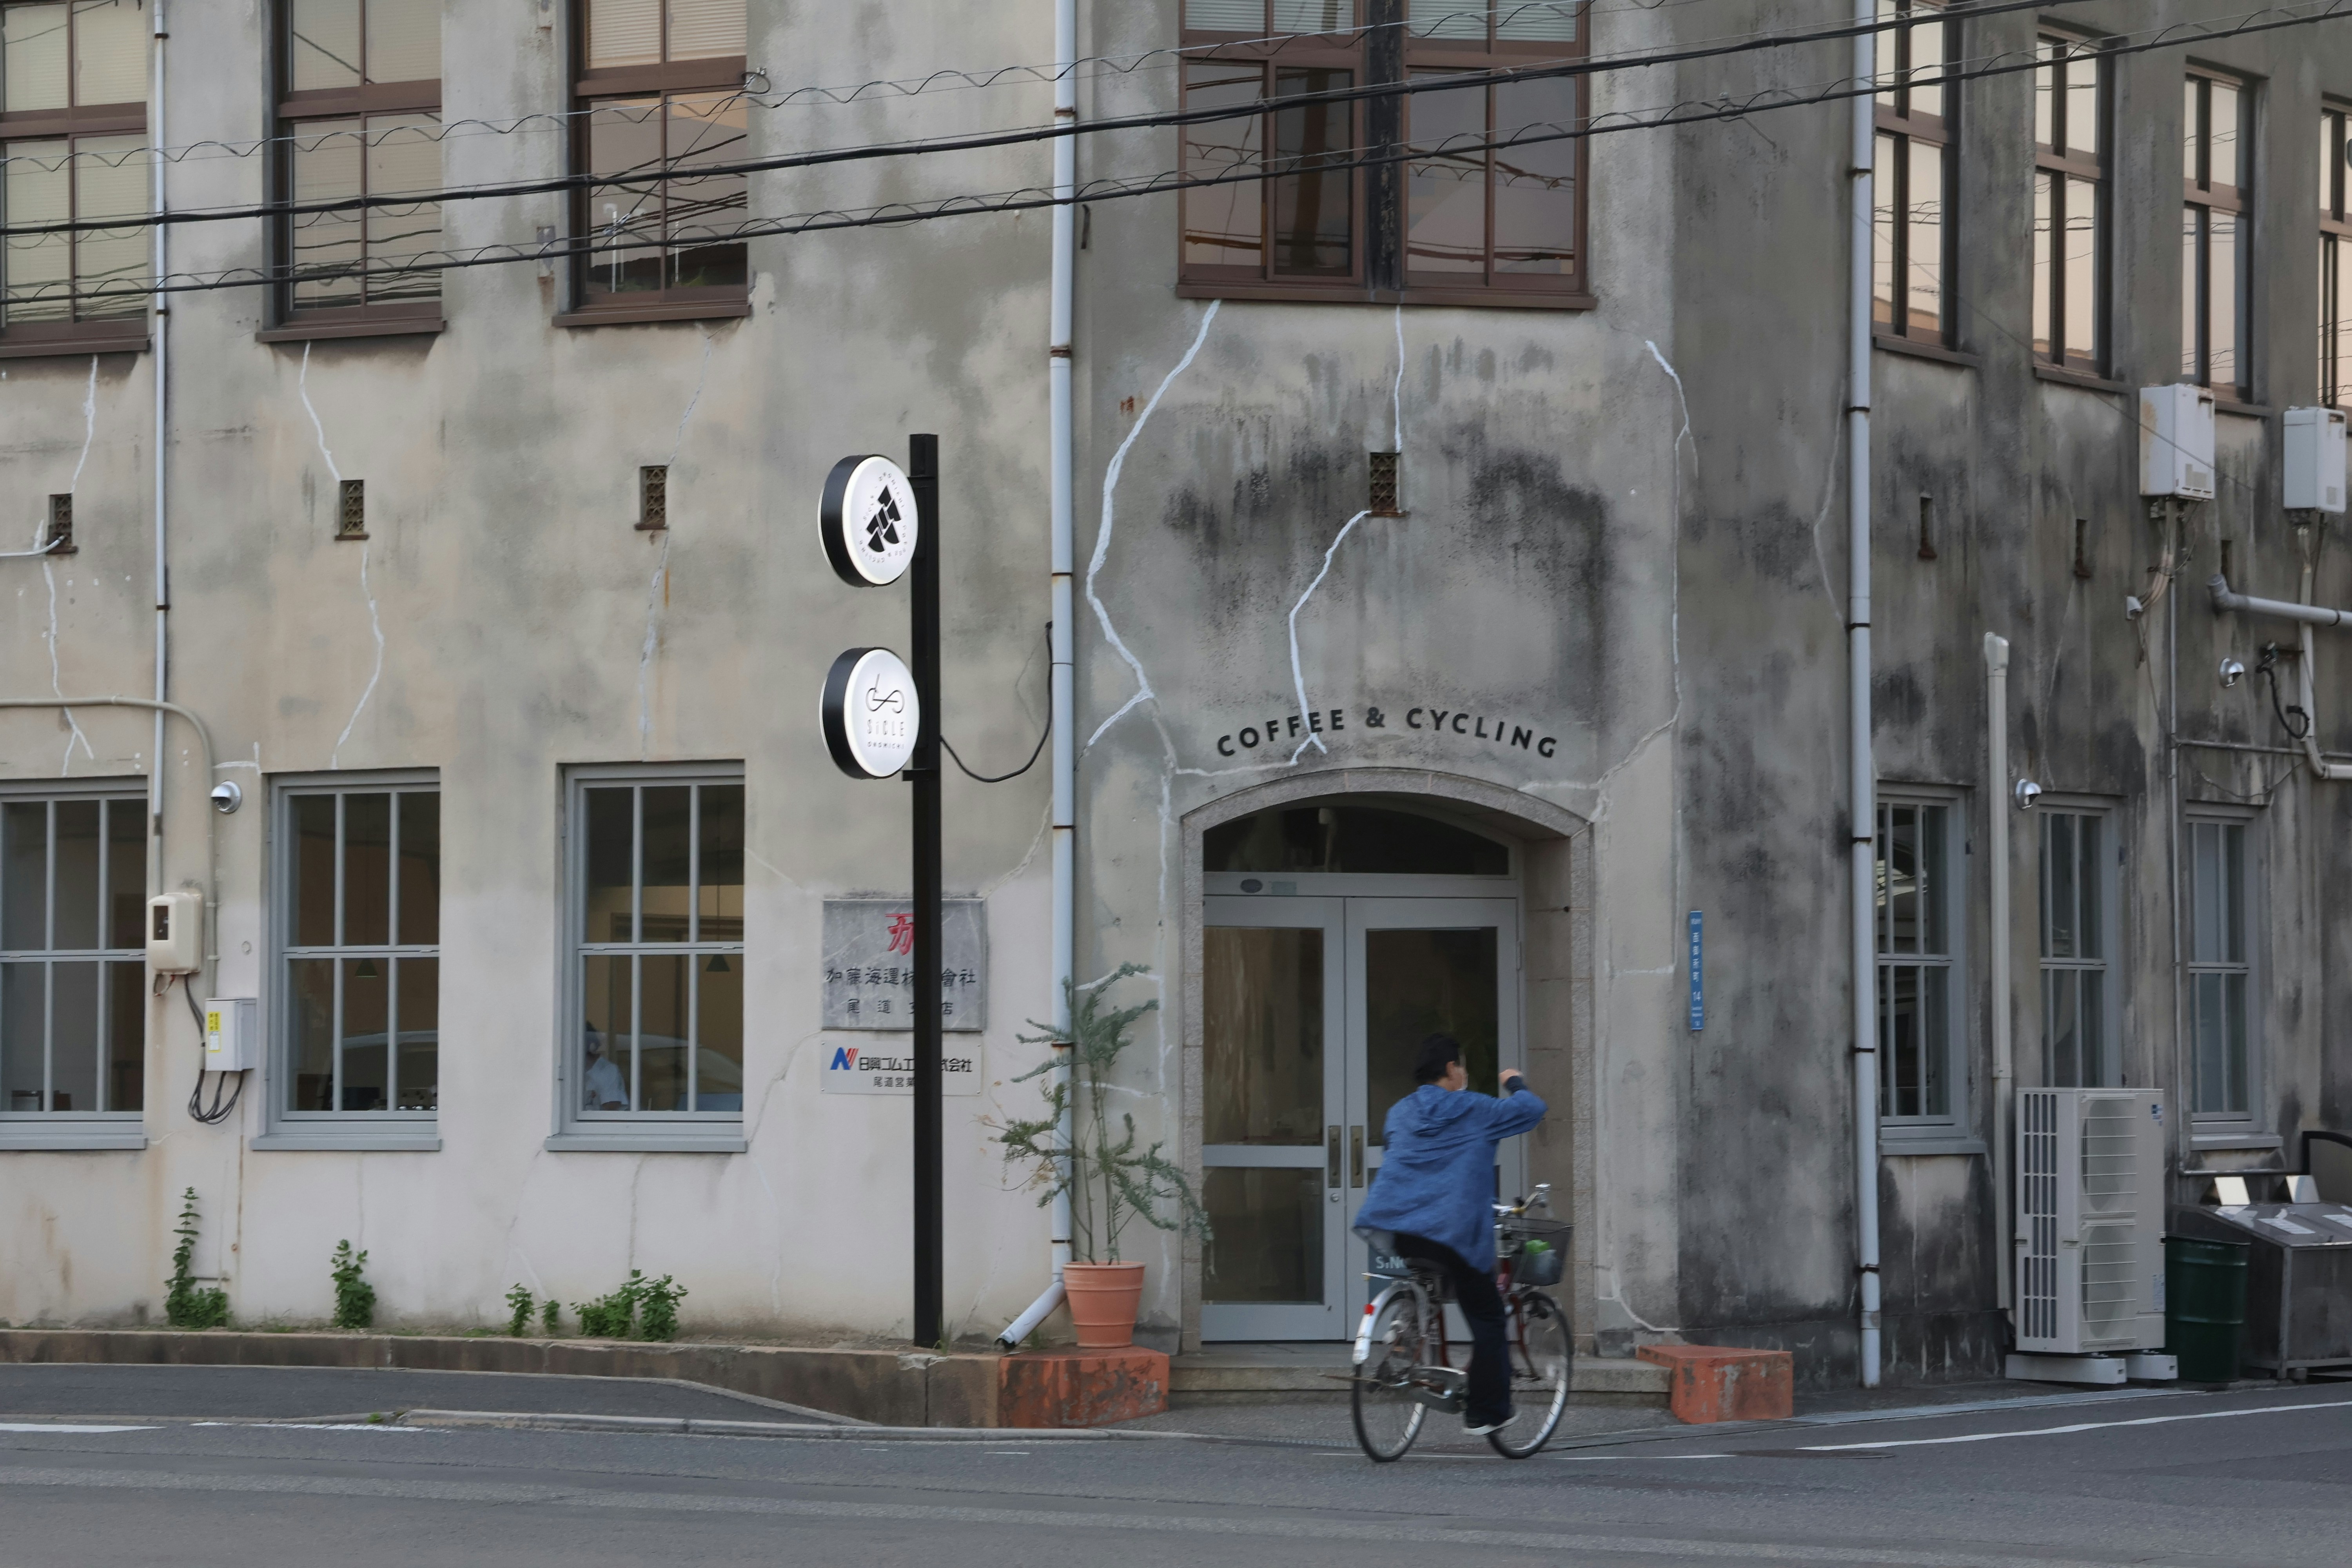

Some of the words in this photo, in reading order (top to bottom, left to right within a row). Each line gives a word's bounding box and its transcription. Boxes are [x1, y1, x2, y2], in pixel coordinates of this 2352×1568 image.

[867, 719, 904, 736] SiCLE
[1218, 709, 1344, 757] COFFEE
[1366, 707, 1385, 728] &
[1406, 708, 1556, 758] CYCLING
